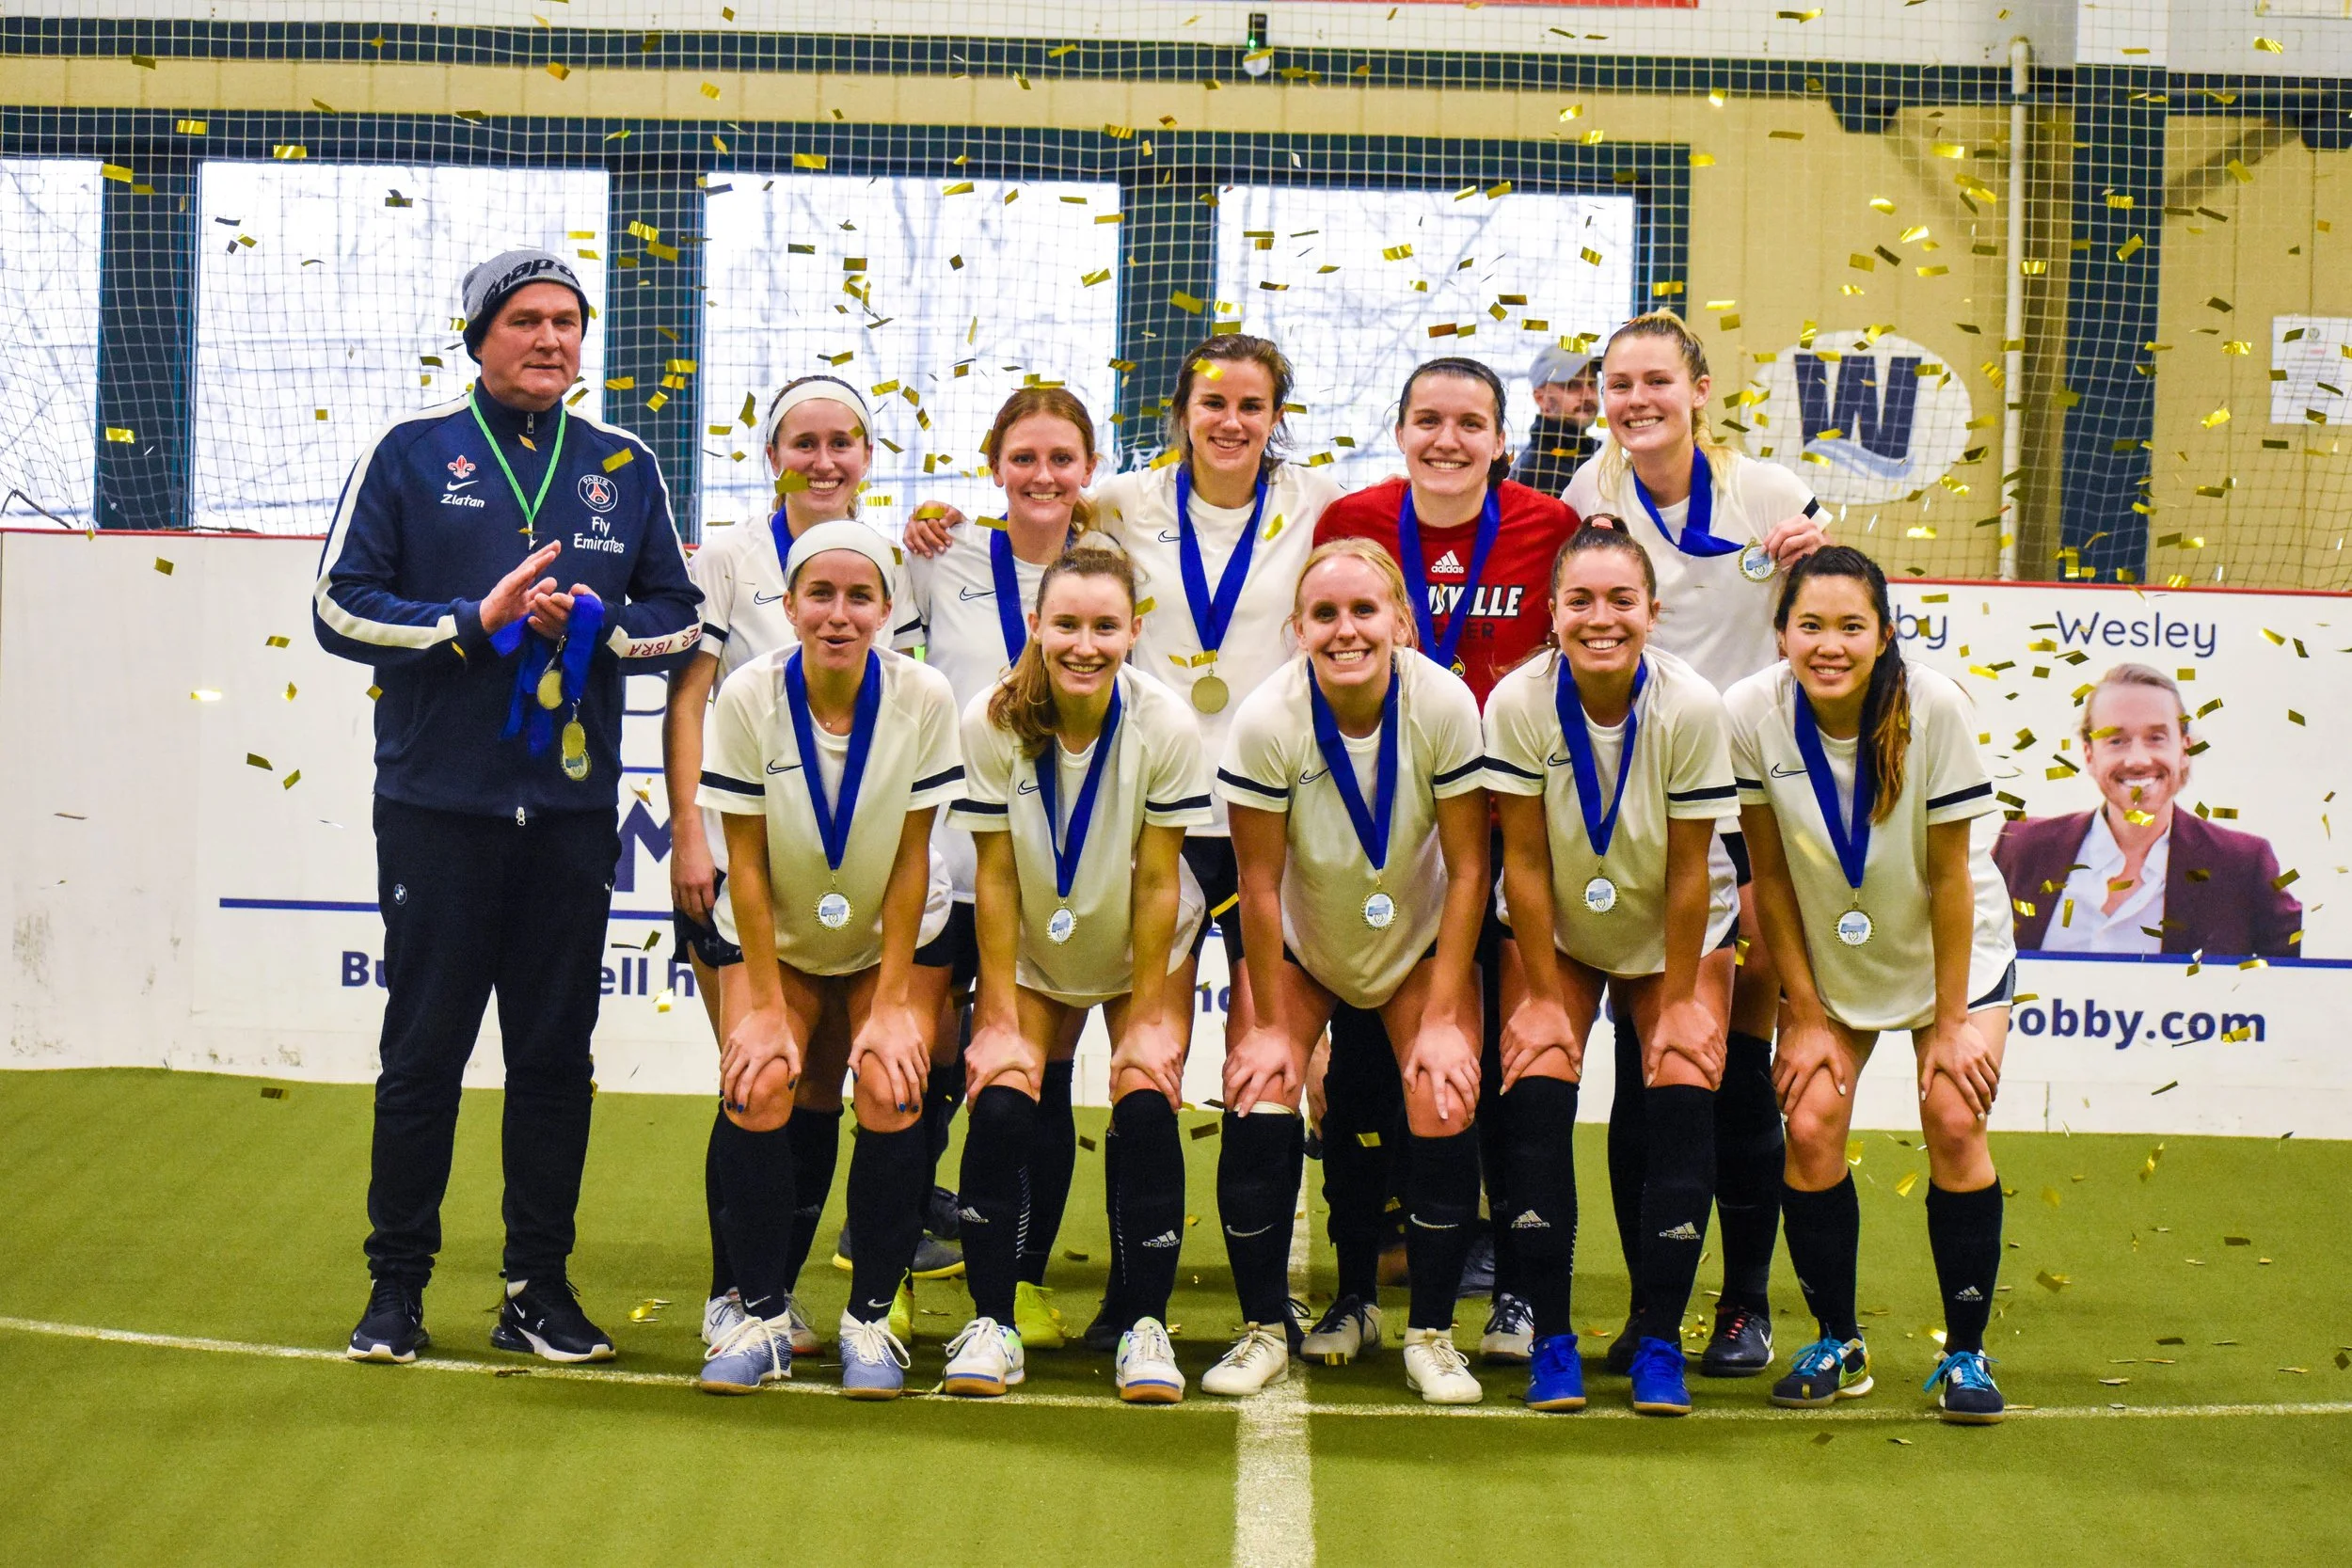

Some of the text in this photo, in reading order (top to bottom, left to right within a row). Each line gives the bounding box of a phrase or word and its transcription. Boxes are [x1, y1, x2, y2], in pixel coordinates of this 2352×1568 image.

[583, 476, 609, 487] PARIS
[440, 493, 485, 508] Zlatan
[591, 515, 611, 538] Fly
[573, 532, 625, 554] Emirates
[1431, 565, 1465, 574] adidas
[2056, 610, 2216, 657] Wesley
[628, 640, 673, 657] IBRA
[2008, 998, 2265, 1051] obby.com
